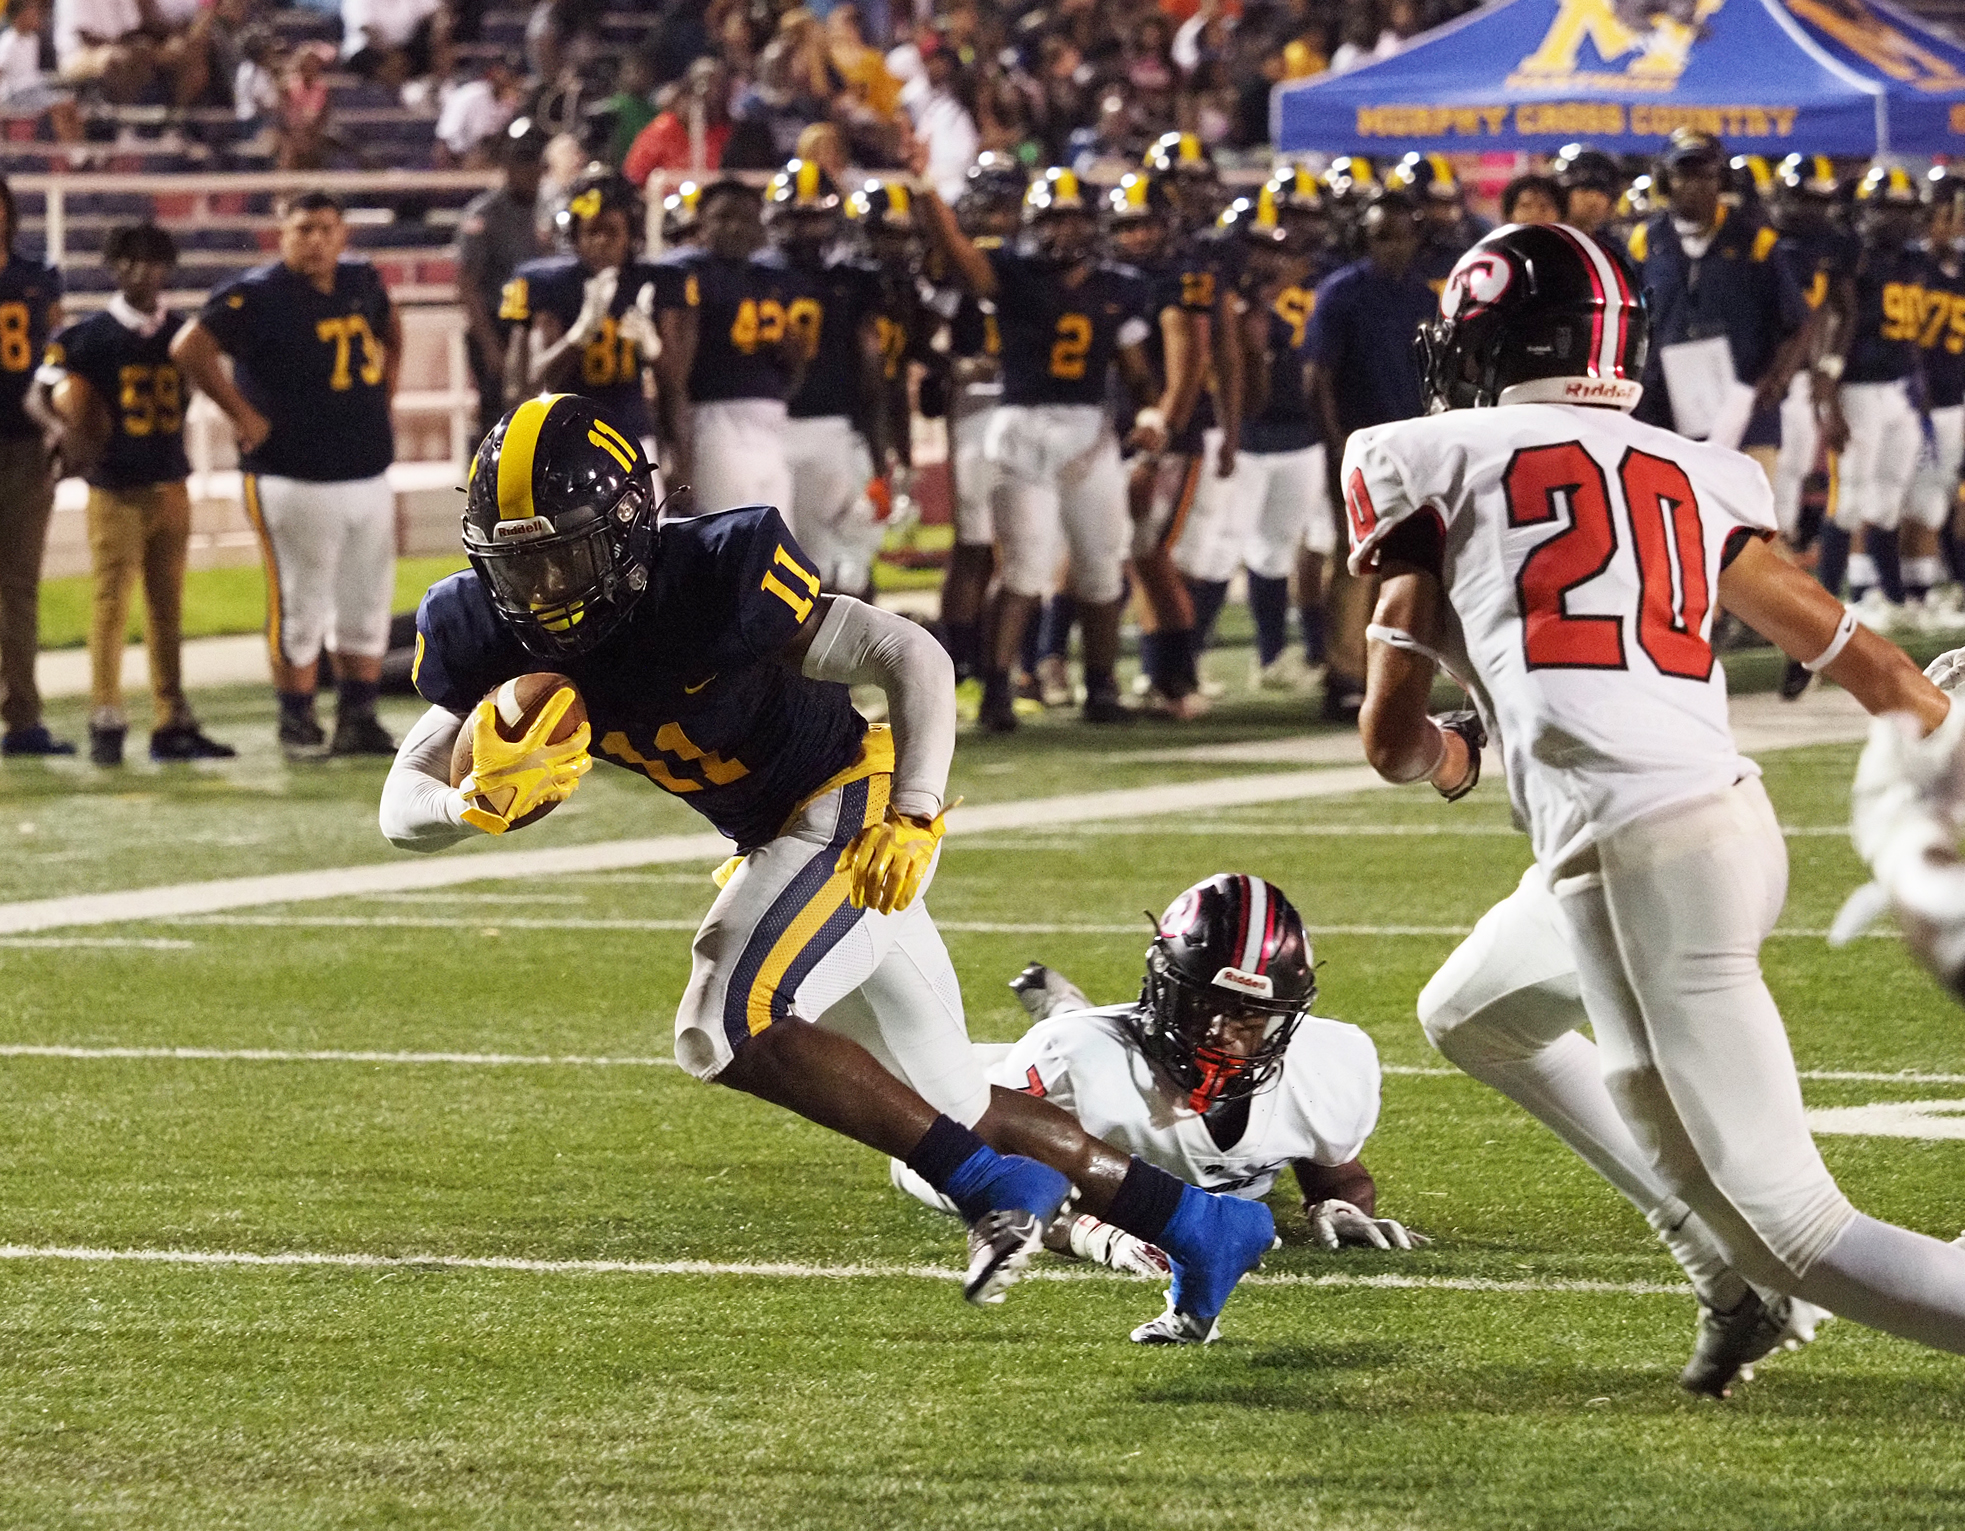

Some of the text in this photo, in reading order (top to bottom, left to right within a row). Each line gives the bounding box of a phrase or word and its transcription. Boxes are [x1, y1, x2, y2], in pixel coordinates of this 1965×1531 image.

[1355, 103, 1798, 137] MURPHY CROSS COUNTRY
[1050, 312, 1093, 379] 2
[587, 418, 637, 473] 11
[498, 520, 543, 537] Riddell
[1502, 439, 1715, 683] 20
[760, 543, 821, 624] 11
[600, 721, 751, 793] 11
